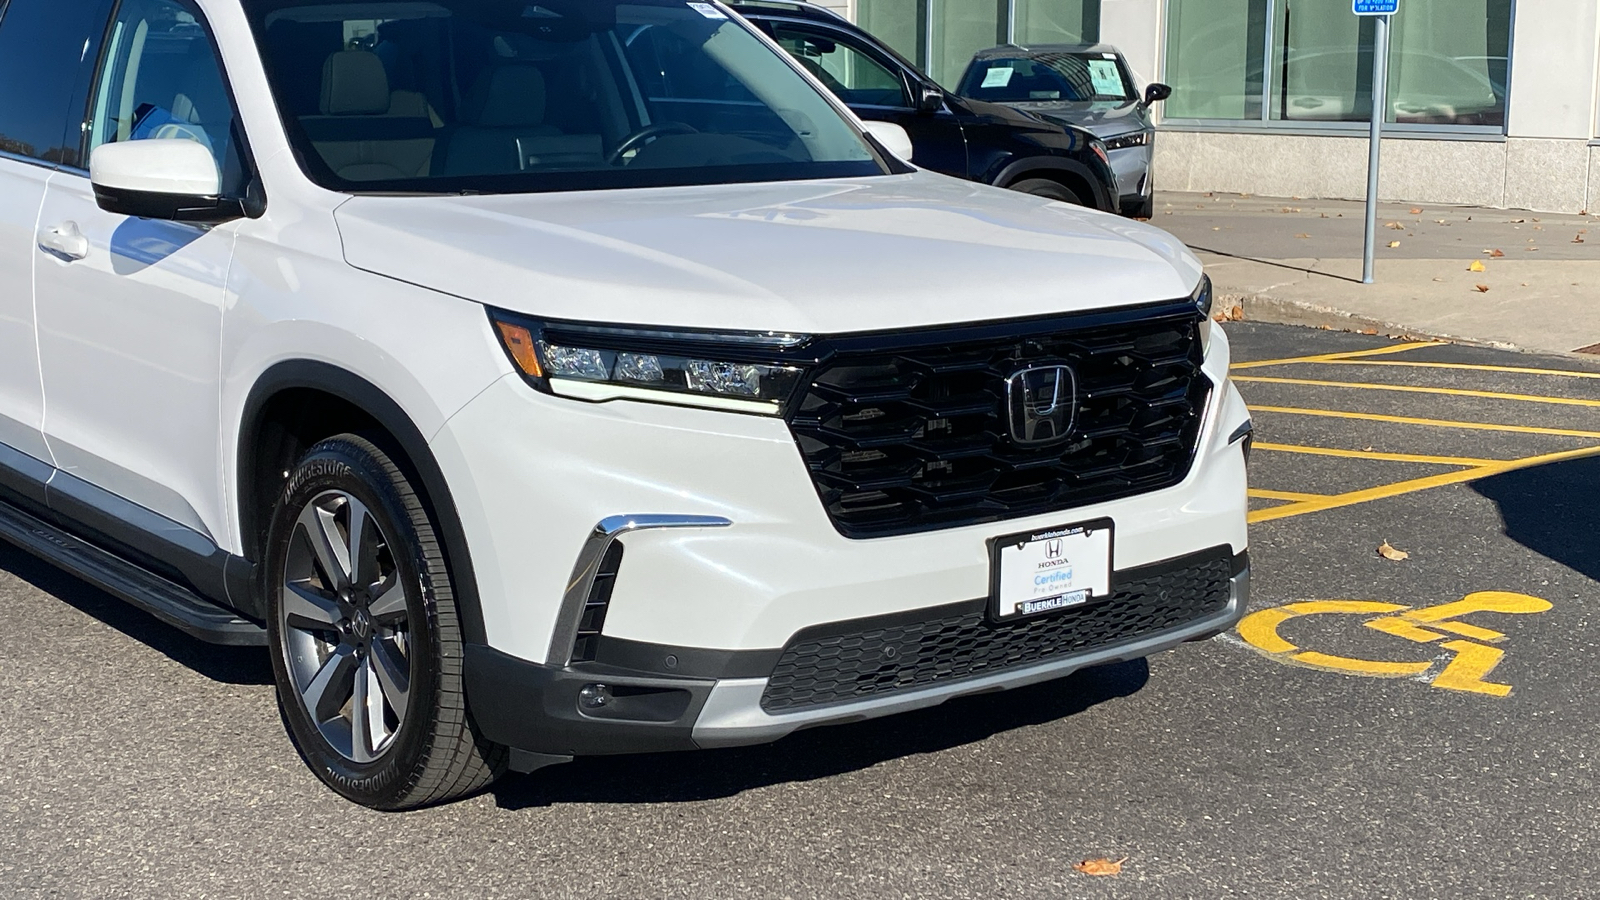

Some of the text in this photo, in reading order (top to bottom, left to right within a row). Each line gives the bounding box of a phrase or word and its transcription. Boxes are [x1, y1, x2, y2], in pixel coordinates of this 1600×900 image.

[1031, 527, 1084, 541] buerklehonda.com
[1038, 558, 1069, 568] HONDA
[1034, 569, 1073, 586] Certified
